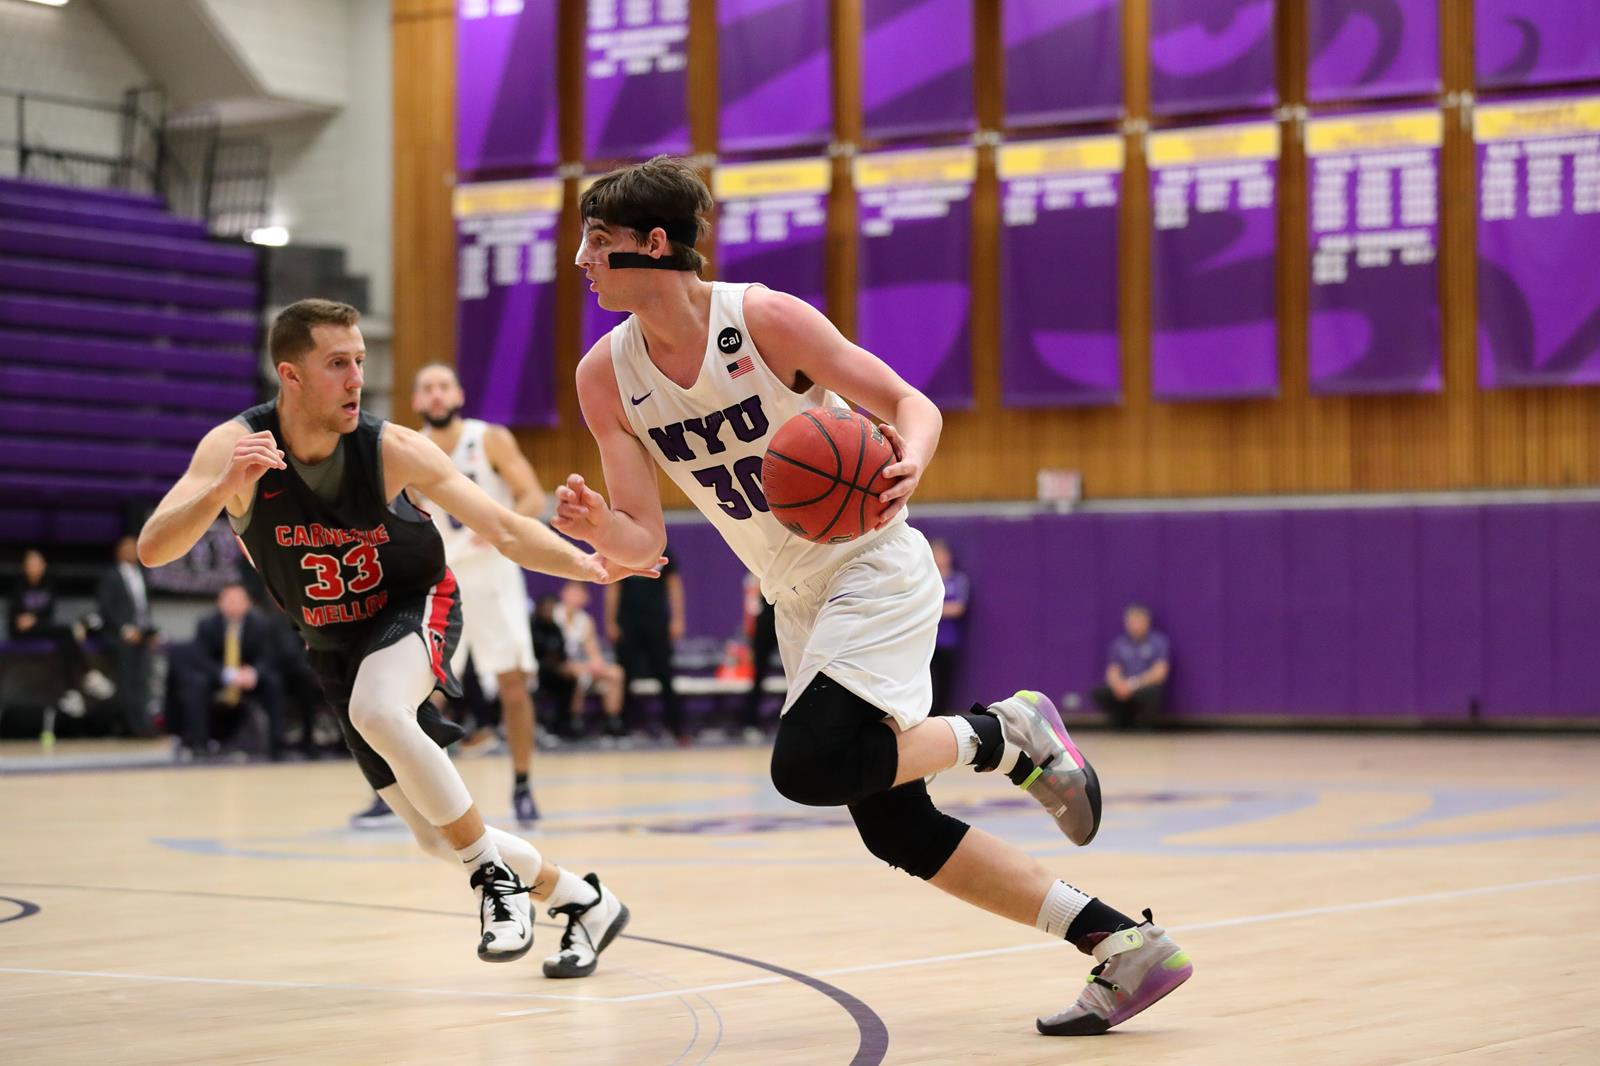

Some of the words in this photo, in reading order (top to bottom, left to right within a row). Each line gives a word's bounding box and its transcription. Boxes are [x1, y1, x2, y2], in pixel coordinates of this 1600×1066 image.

[720, 332, 740, 348] Cal
[648, 394, 770, 462] NYU
[690, 455, 770, 520] 30
[301, 542, 384, 600] 33
